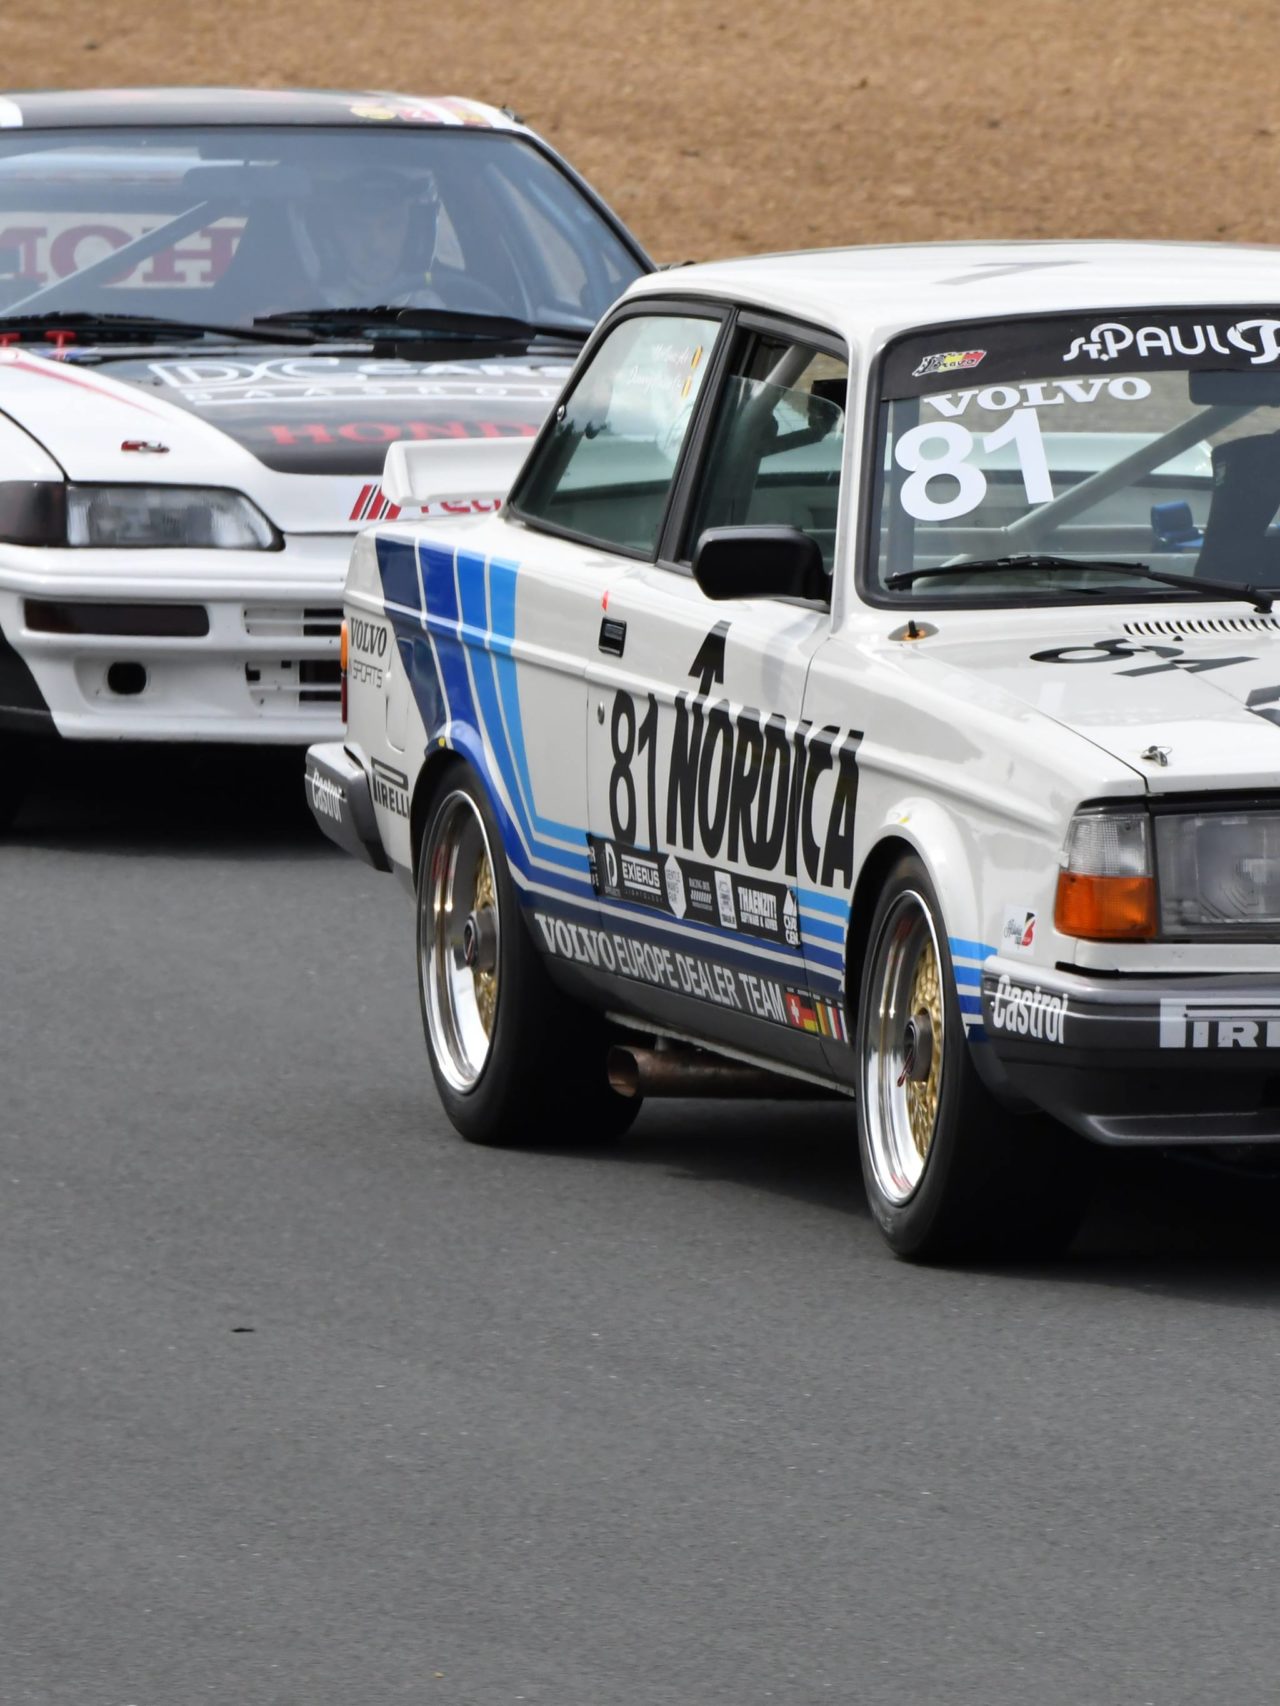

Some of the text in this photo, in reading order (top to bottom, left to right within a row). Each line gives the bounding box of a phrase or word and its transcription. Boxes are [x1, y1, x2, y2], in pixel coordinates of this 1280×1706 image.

[924, 377, 1151, 417] VOLVO
[267, 420, 541, 445] HOND
[894, 408, 1054, 521] 81
[351, 617, 387, 658] VOLVO
[353, 660, 383, 689] SPORTS
[371, 756, 410, 819] PIRELLI
[609, 689, 864, 890] 81 NORDICA
[534, 913, 788, 1023] VOLVO EUROPE DEALER TEAM
[993, 974, 1068, 1044] Castrol
